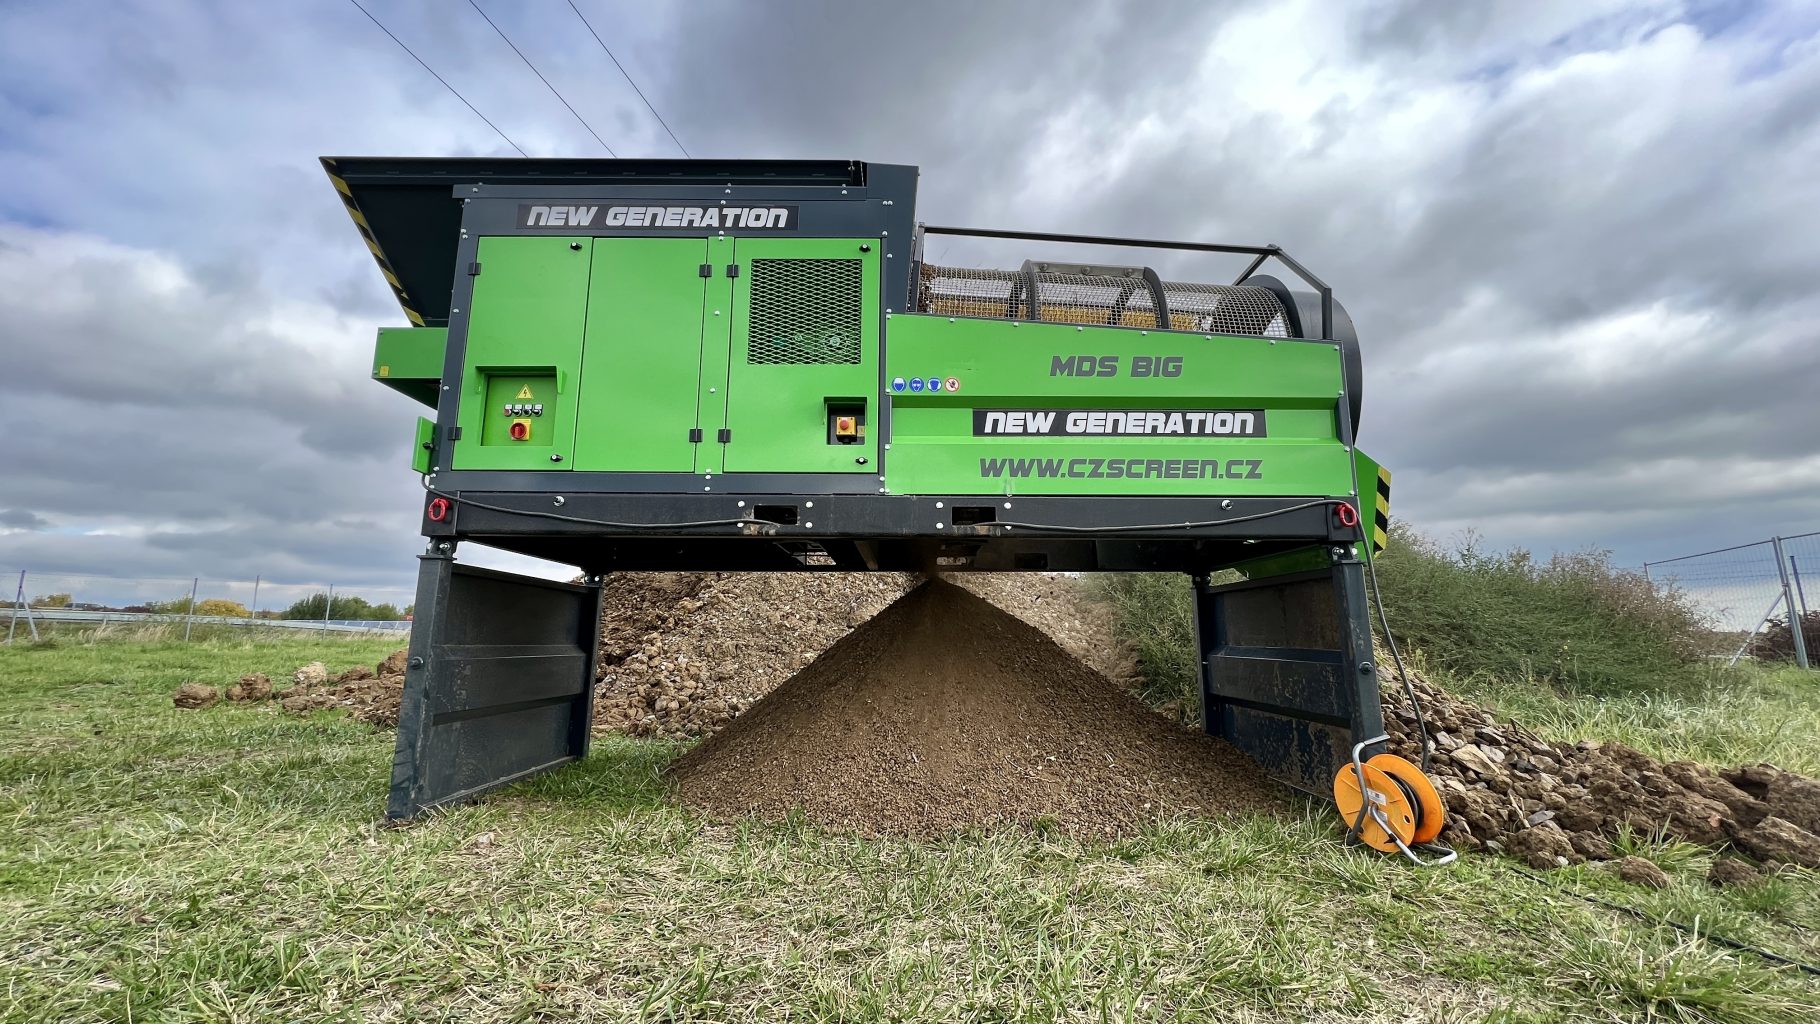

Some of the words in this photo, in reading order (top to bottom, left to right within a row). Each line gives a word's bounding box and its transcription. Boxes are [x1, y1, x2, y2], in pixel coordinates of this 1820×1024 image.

[527, 206, 599, 227] NEW
[605, 206, 789, 228] GENERATION
[1050, 356, 1119, 377] MDS
[1130, 356, 1184, 378] BIG
[983, 412, 1056, 434] NEW
[1065, 412, 1256, 434] GENERATION
[980, 458, 1263, 479] WWW.CZSCREEN.CZ
